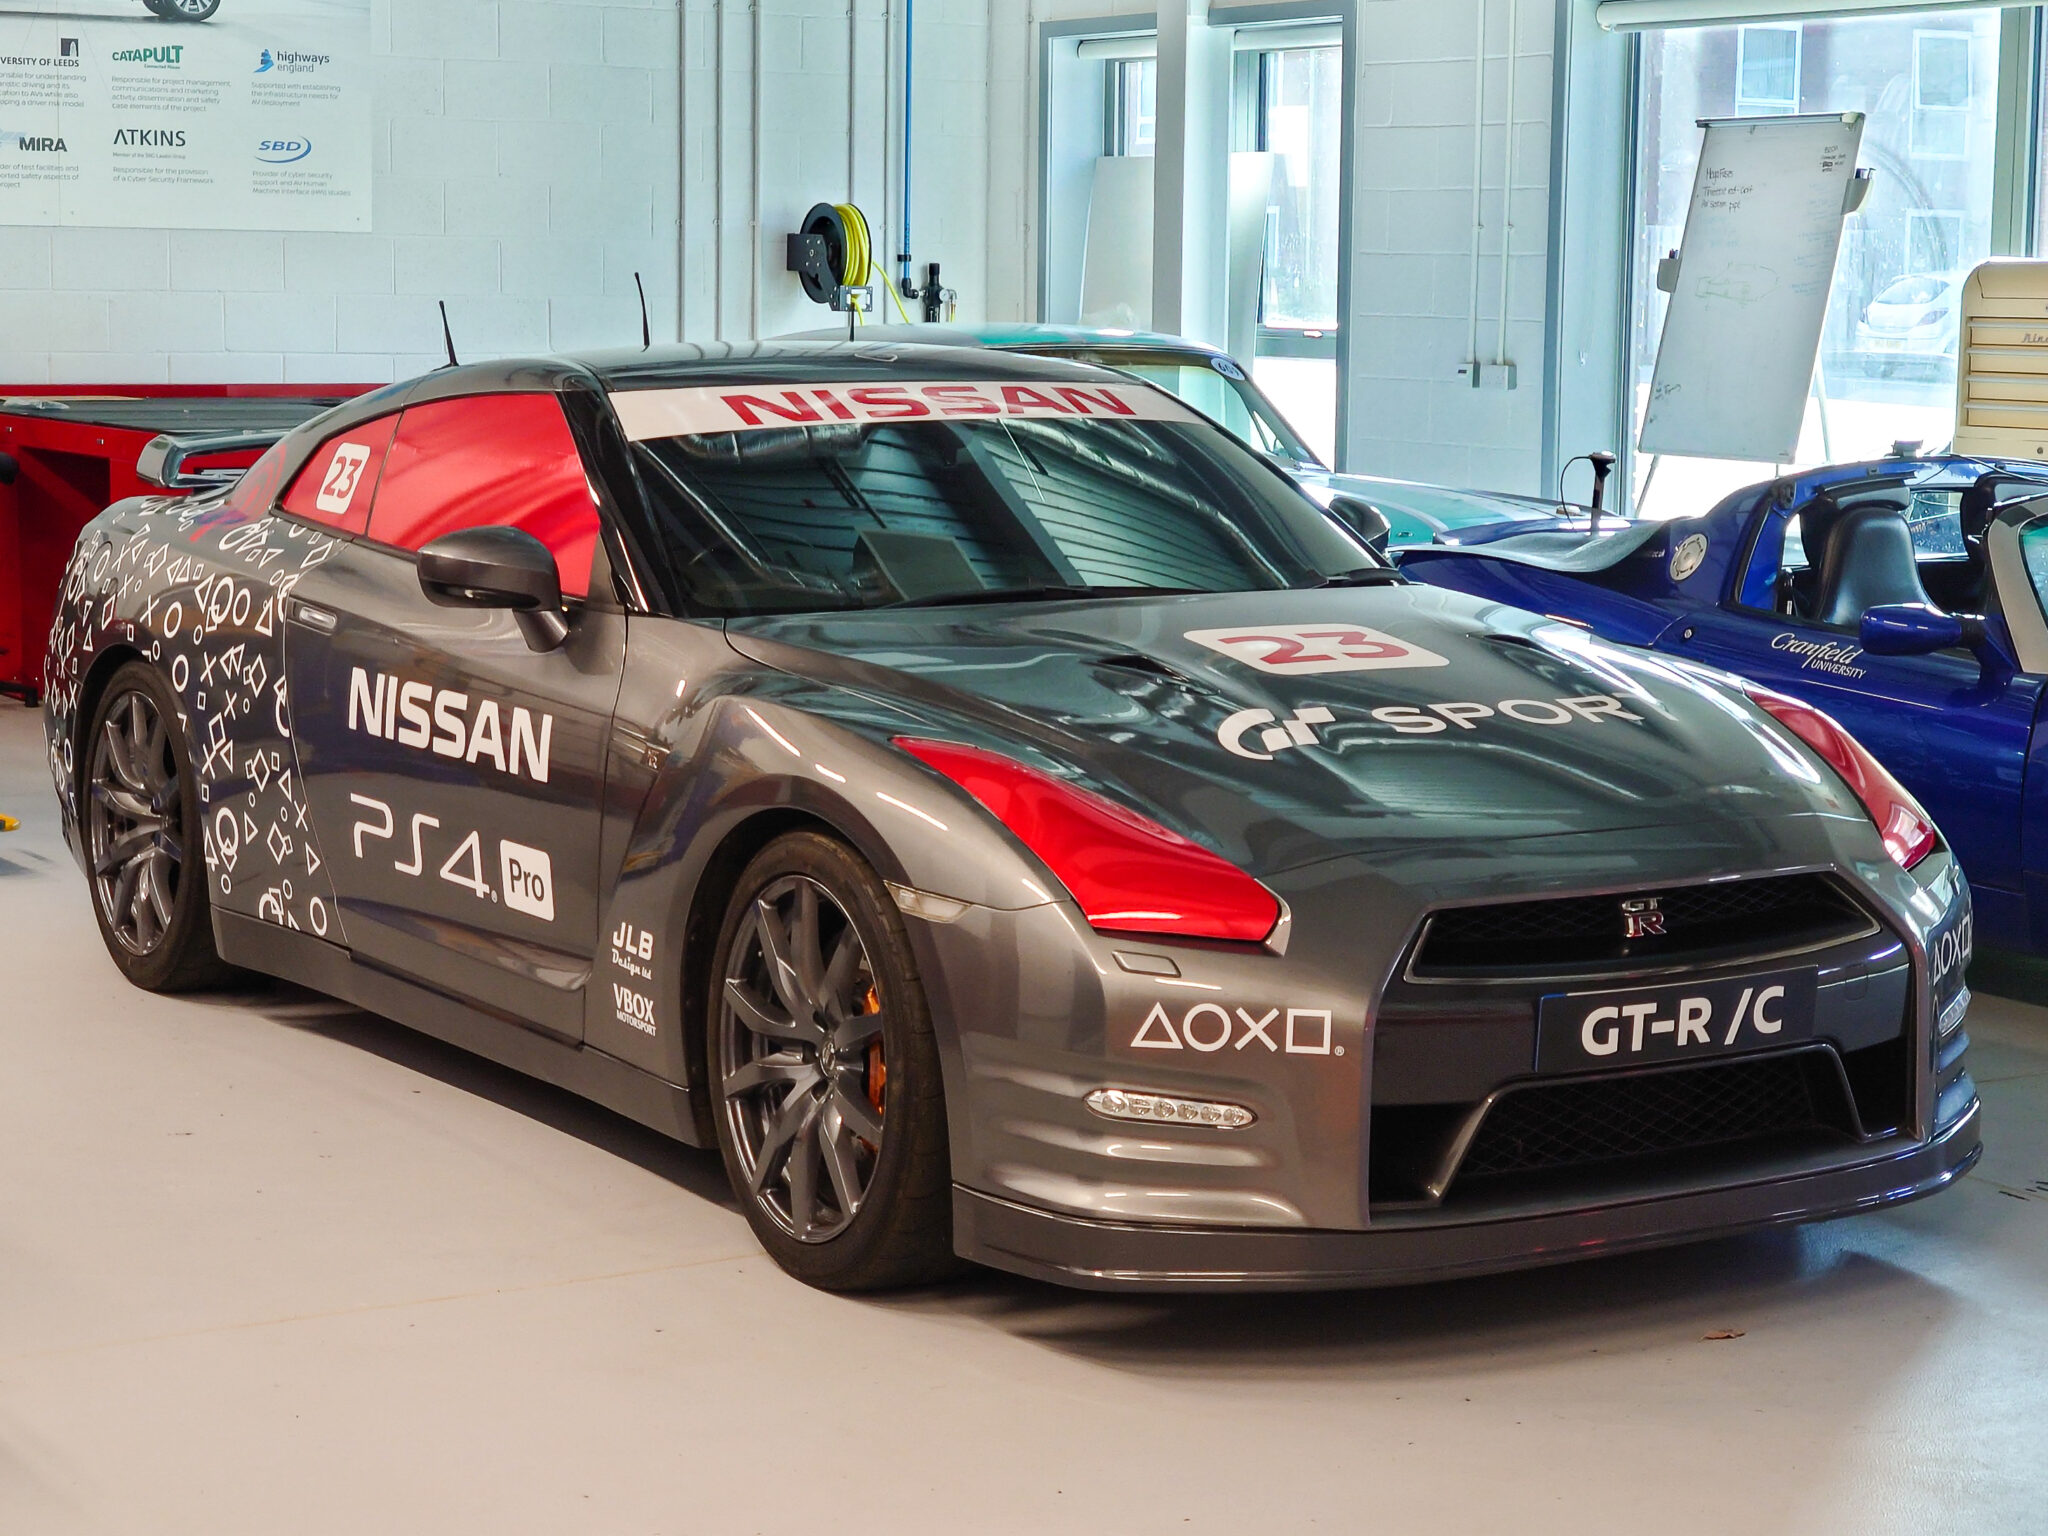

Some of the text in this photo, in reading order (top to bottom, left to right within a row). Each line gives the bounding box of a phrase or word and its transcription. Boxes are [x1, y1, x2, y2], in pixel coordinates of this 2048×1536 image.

[39, 58, 51, 66] OF
[53, 58, 79, 67] LEEDS
[112, 45, 183, 63] CATAPULT
[277, 51, 330, 65] highways
[277, 63, 314, 74] england
[19, 136, 68, 152] MIRA
[113, 129, 186, 146] ATKINS
[259, 140, 301, 151] SBD
[720, 385, 1137, 427] NISSAN
[324, 455, 363, 499] 23
[1218, 631, 1410, 665] 23
[1771, 632, 1864, 670] Cranfield
[1811, 658, 1867, 680] UNIVERSITY
[348, 666, 553, 784] NISSAN
[350, 792, 546, 903] PS4 Pro
[1621, 897, 1663, 912] GT
[1624, 911, 1668, 938] R
[612, 921, 654, 961] JLB
[611, 948, 641, 977] Design
[613, 982, 656, 1026] VBOX
[616, 1009, 657, 1037] MOTORSPORT
[1581, 985, 1785, 1057] GT-R /C
